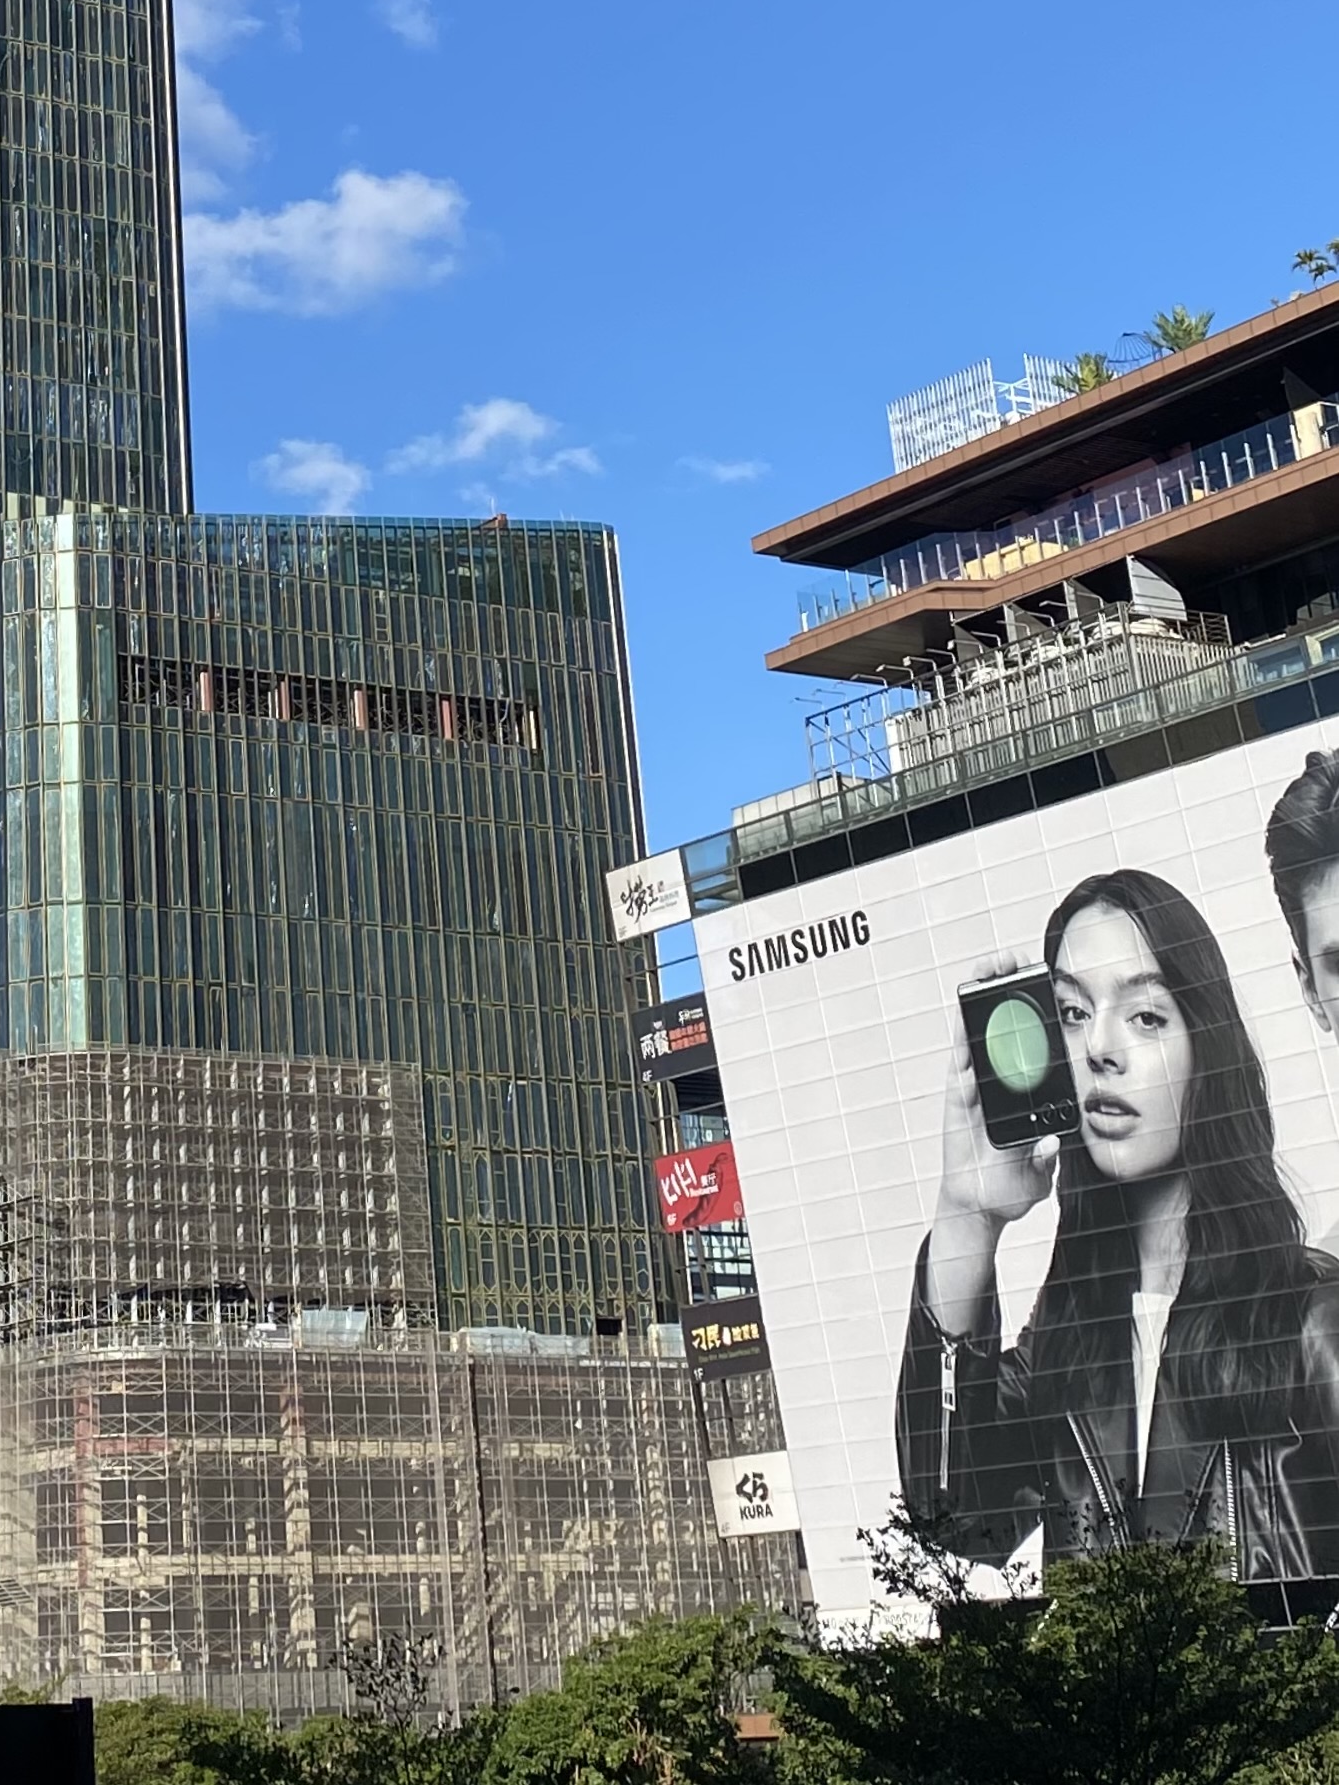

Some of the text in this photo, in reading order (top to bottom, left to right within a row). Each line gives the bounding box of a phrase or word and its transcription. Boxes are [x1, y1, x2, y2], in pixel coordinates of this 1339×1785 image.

[728, 910, 871, 982] SAMSUNG
[735, 1471, 769, 1504] くら
[739, 1503, 774, 1521] KURA
